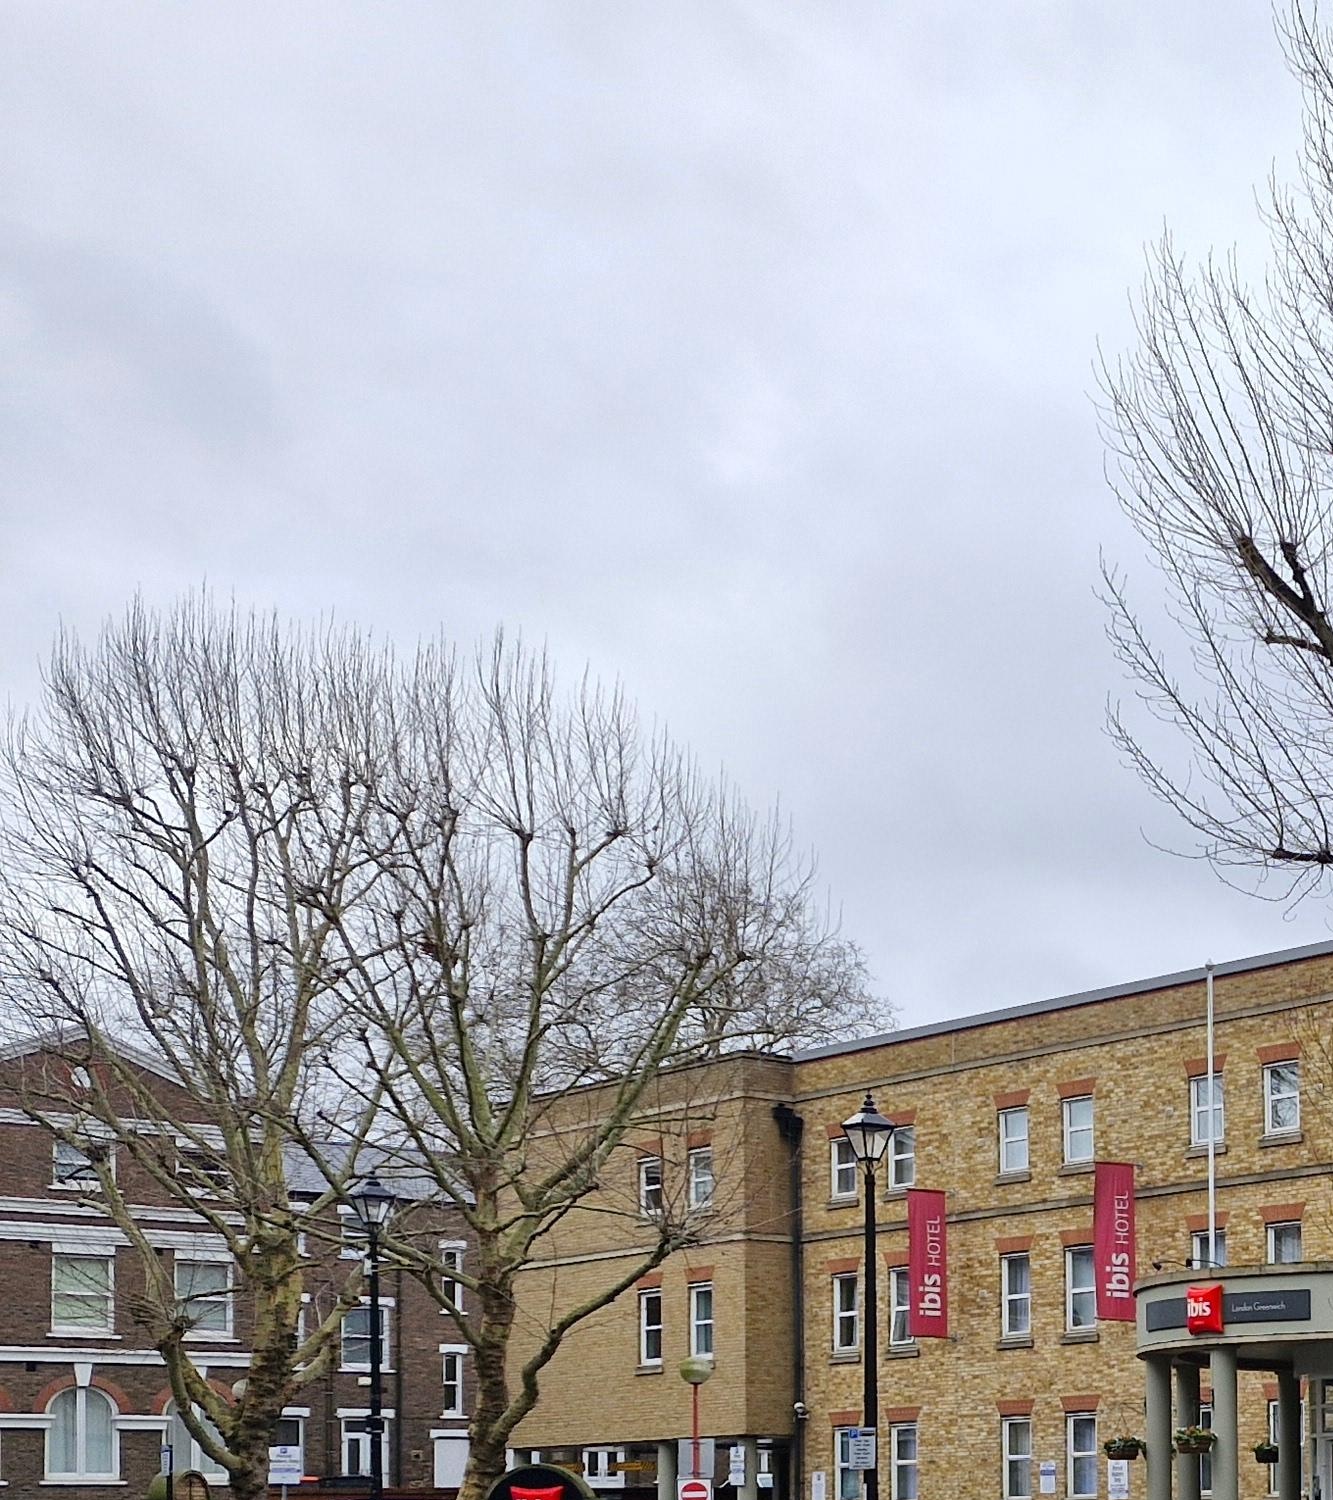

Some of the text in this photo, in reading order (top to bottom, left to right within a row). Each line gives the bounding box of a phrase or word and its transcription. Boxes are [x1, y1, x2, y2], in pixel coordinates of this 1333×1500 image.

[919, 1215, 942, 1317] ibis HOTEL
[1105, 1191, 1130, 1298] ibis HOTEL
[1187, 1297, 1211, 1317] ibis
[1231, 1302, 1253, 1312] London
